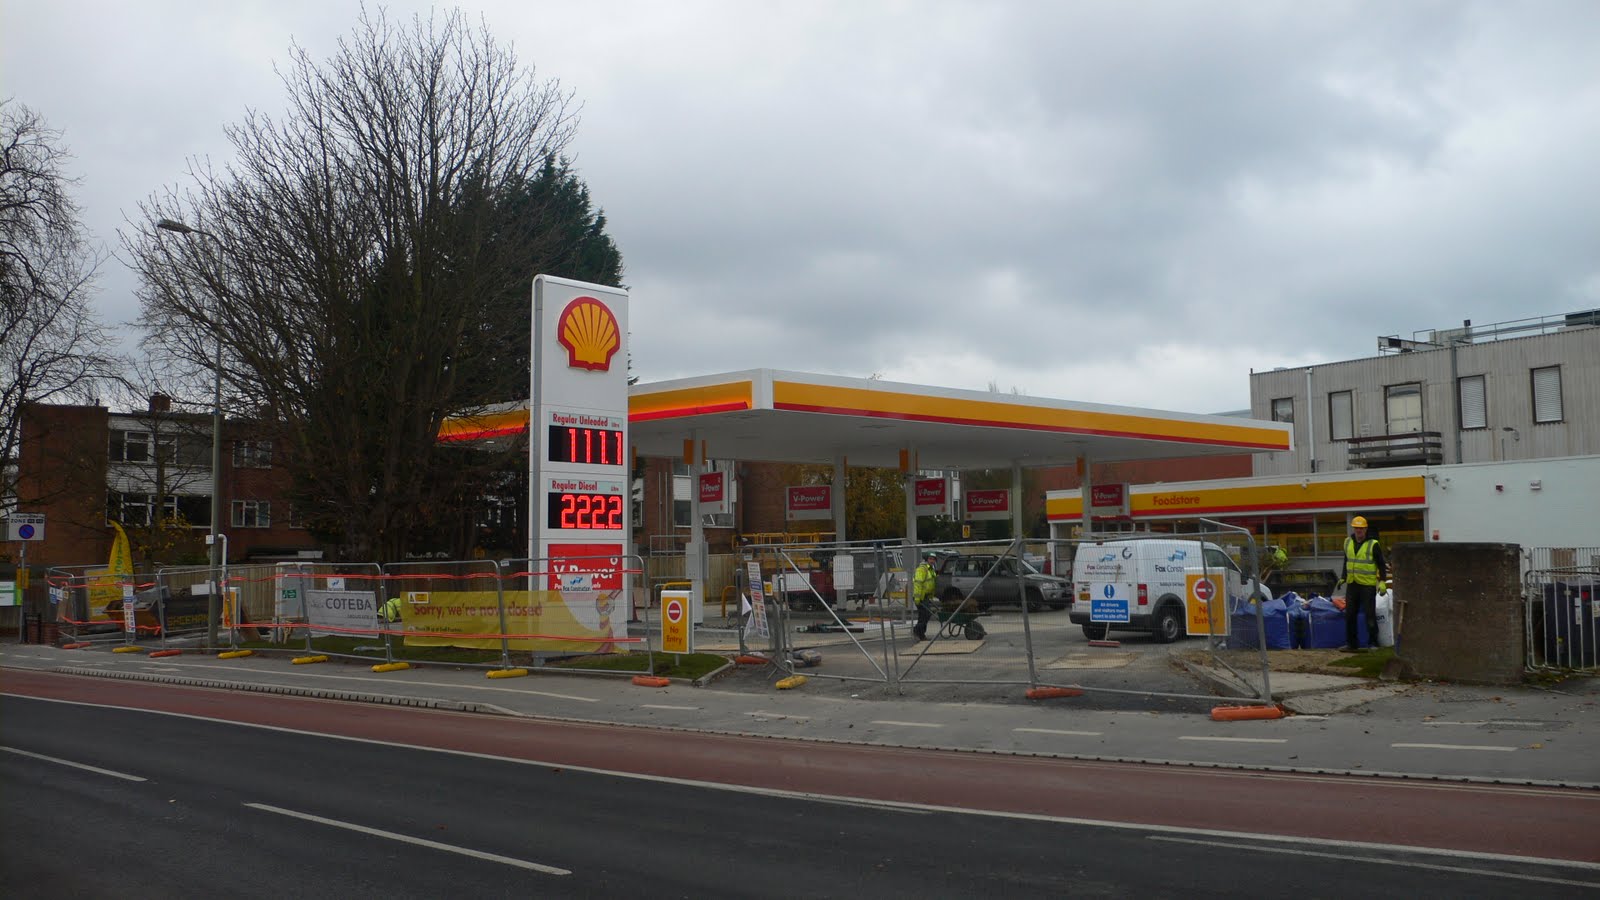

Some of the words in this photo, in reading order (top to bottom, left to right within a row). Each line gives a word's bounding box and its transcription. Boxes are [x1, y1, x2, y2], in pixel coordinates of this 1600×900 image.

[553, 413, 577, 425] Regular
[580, 416, 608, 426] Unleaded
[552, 480, 577, 492] Regular
[579, 481, 598, 491] Diesel
[793, 495, 825, 503] V-Power
[971, 497, 1003, 505] V-Power
[1153, 494, 1201, 506] Foodstore
[553, 564, 615, 579] VPwer
[325, 598, 373, 611] COTEBA
[414, 603, 445, 619] Sorry,
[448, 602, 476, 616] we're
[508, 601, 543, 616] closed
[1194, 616, 1217, 625] Enty
[670, 626, 679, 634] No
[666, 635, 683, 645] Entry
